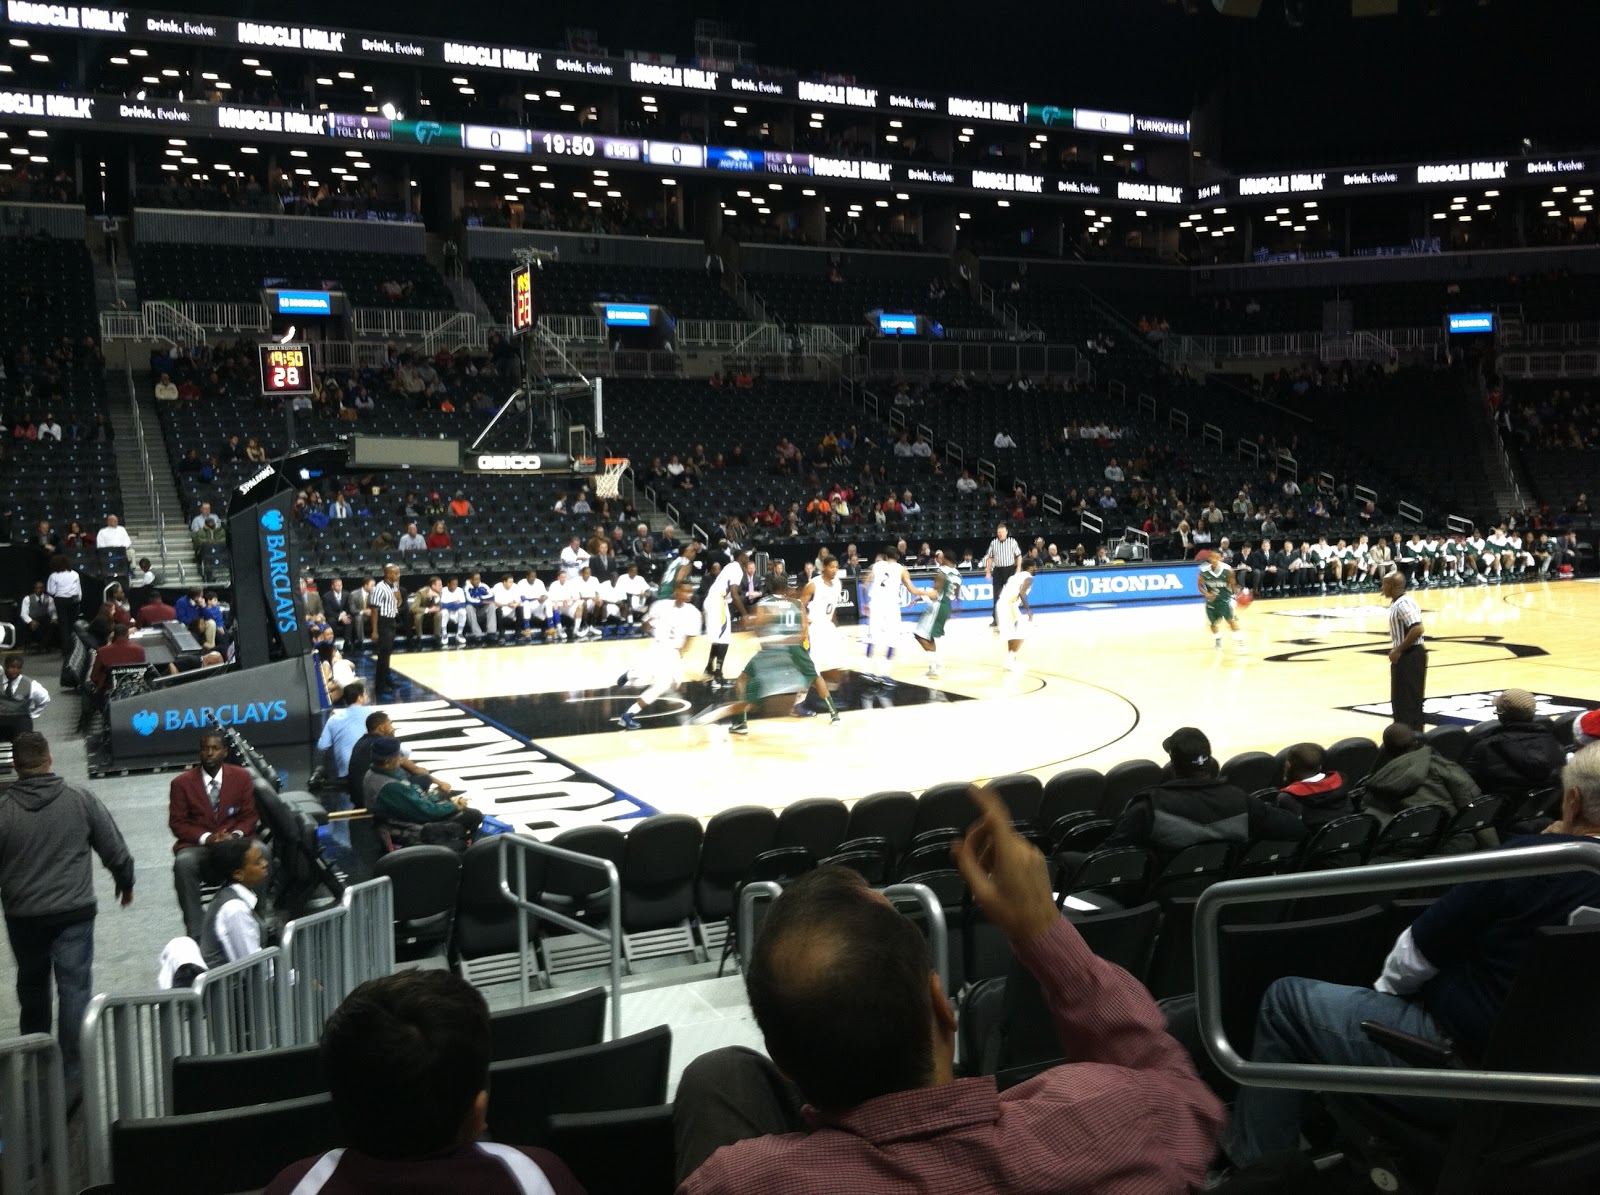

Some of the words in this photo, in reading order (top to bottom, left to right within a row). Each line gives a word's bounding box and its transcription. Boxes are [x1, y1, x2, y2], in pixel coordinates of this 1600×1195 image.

[8, 1, 79, 28] MUSCLE
[81, 9, 129, 32] MILK
[238, 22, 300, 49] MUSCLE
[303, 28, 346, 52] MILK
[444, 42, 501, 67] MUSCLE
[503, 48, 541, 71] MILK
[631, 62, 682, 86] MUSCLE
[684, 67, 719, 90] MILK
[798, 81, 844, 105] MUSCLE
[846, 86, 878, 107] MILK
[47, 97, 94, 119] MILK
[948, 97, 990, 119] MUSCLE
[992, 102, 1021, 122] MILK
[218, 107, 281, 132] MUSCLE
[284, 112, 327, 135] MILK
[1136, 119, 1184, 134] TURNOVERS
[490, 131, 501, 149] 0
[542, 134, 595, 156] 19:50
[672, 146, 682, 164] 0
[814, 157, 859, 179] MUSCLE
[861, 161, 892, 181] MILK
[1418, 164, 1469, 183] MUSCLE
[1471, 162, 1508, 179] MILK
[973, 170, 1014, 190] MUSCLE
[1016, 174, 1044, 193] MILK
[1118, 182, 1156, 201] MUSCLE
[1158, 185, 1183, 203] MILK
[1240, 176, 1288, 195] MUSCLE
[1290, 173, 1325, 191] MILK
[270, 351, 303, 366] 19:50
[274, 367, 299, 387] 28
[478, 455, 541, 470] GEICO
[239, 464, 275, 495] SPALDING
[267, 534, 298, 633] BARCLAYS
[1091, 574, 1183, 593] HONDA
[164, 700, 288, 730] BARCLAYS
